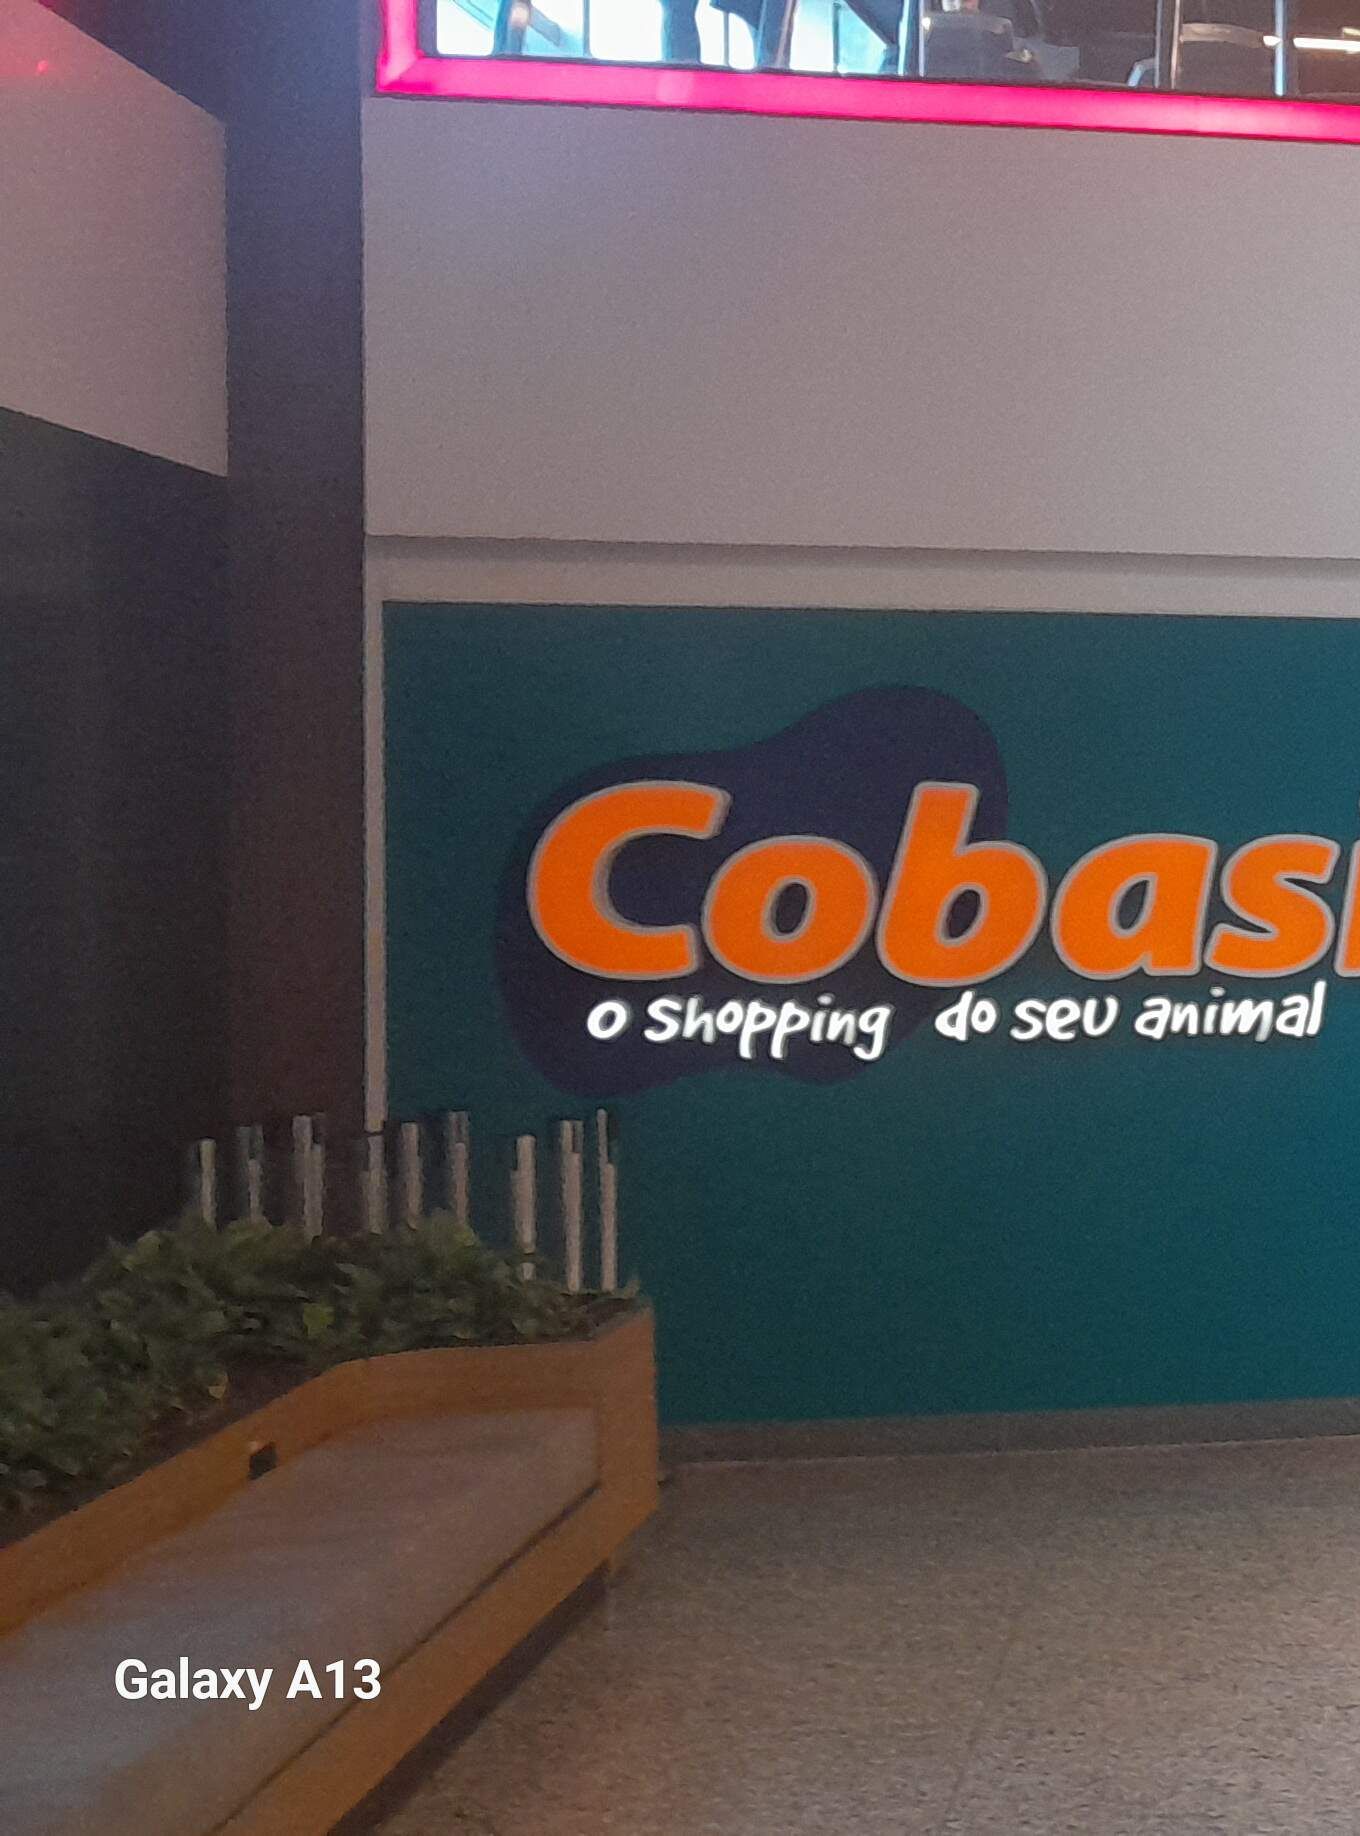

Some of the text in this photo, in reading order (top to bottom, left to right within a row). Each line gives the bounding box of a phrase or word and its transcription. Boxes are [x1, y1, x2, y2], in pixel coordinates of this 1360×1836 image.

[587, 999, 629, 1040] o
[935, 990, 997, 1042] do
[1009, 994, 1120, 1041] seu
[1134, 979, 1328, 1043] animal
